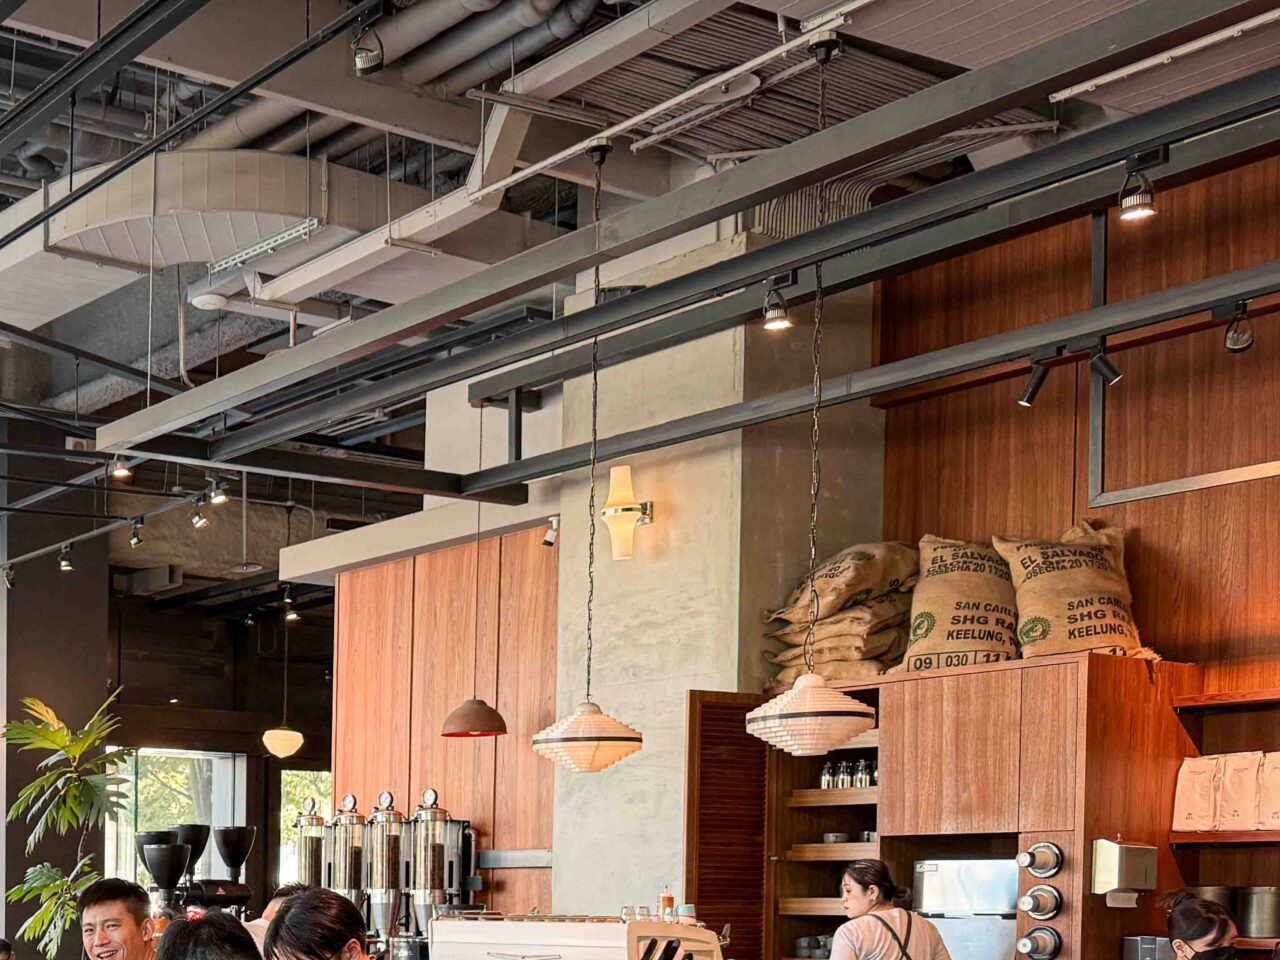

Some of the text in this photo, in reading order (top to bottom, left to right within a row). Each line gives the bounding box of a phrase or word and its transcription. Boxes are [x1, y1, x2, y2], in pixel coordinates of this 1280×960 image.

[931, 555, 947, 565] EL
[1020, 555, 1037, 571] EL
[954, 601, 980, 611] SAN
[1067, 597, 1094, 611] SAN
[950, 615, 989, 625] SHG
[1066, 609, 1107, 624] SHG
[946, 628, 1006, 646] KEELUNG,
[1067, 623, 1128, 640] KEELUNG,
[913, 656, 933, 670] 09
[945, 653, 969, 667] 030
